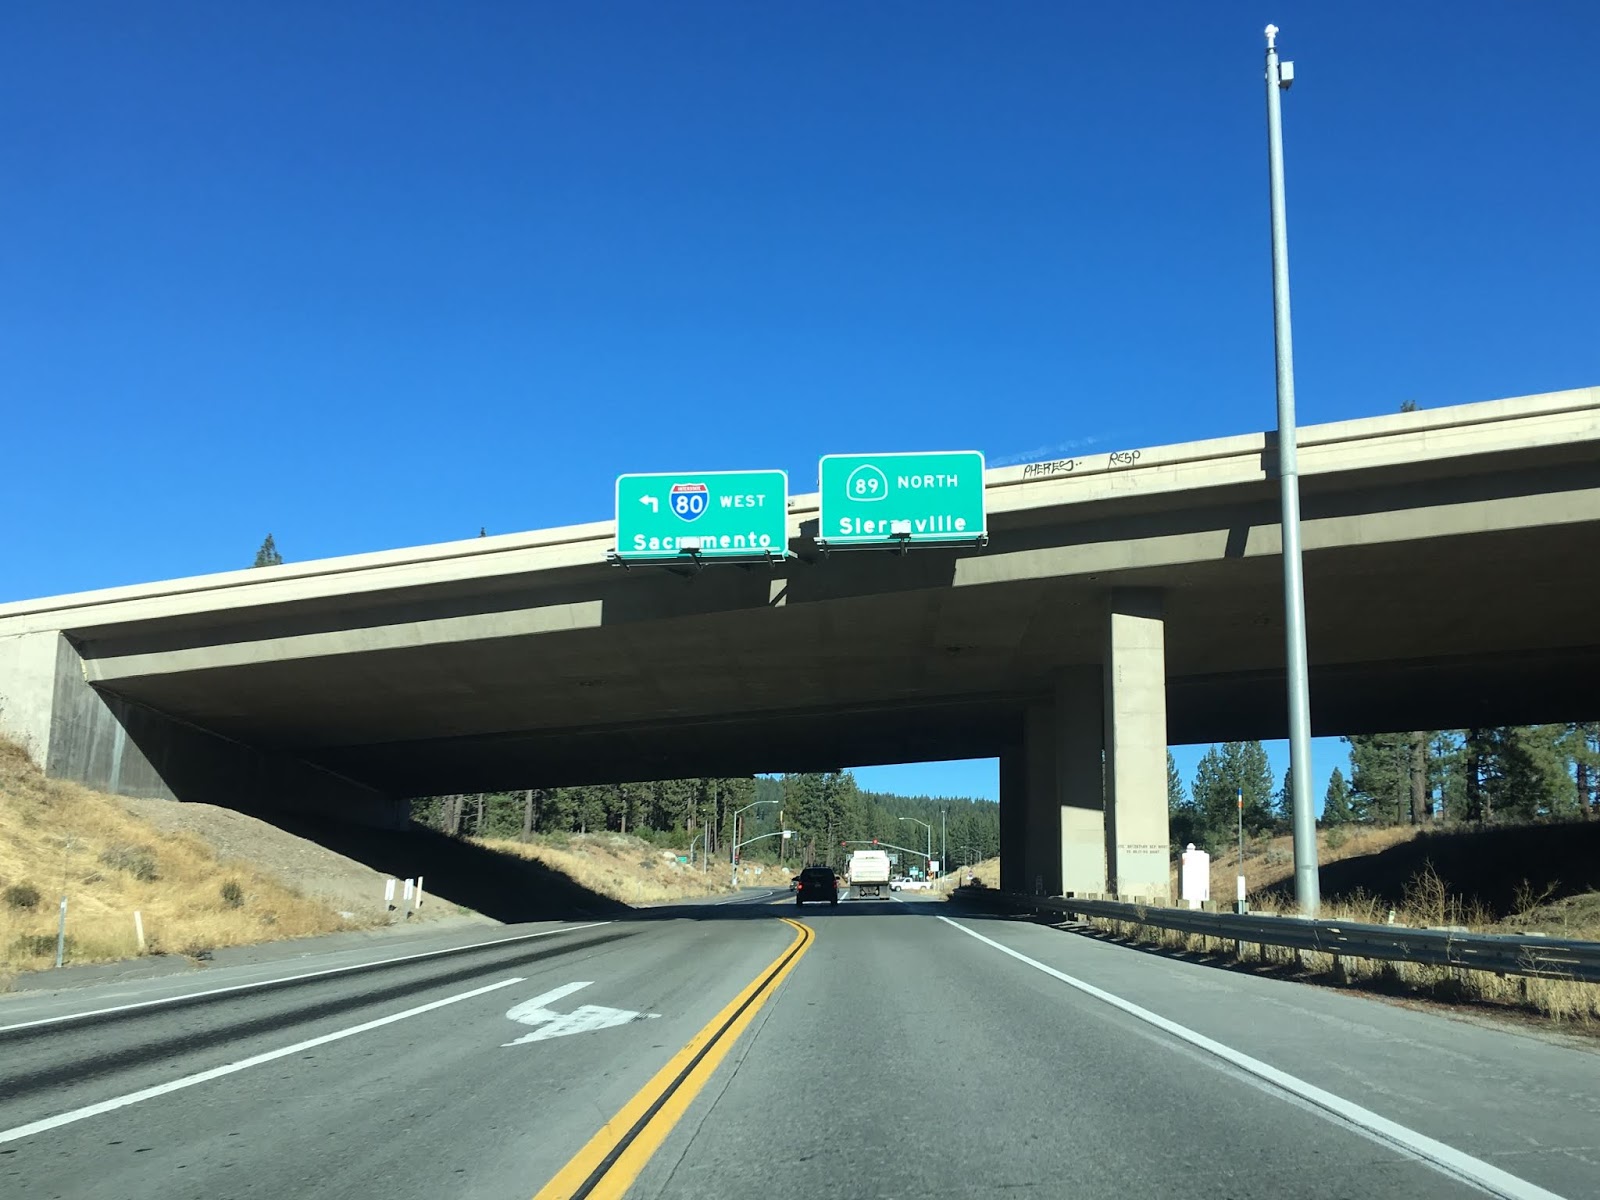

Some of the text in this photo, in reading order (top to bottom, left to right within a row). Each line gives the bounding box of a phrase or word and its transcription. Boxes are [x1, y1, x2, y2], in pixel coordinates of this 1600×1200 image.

[1107, 450, 1141, 470] RESP
[855, 474, 959, 495] 89 NORTH
[675, 494, 766, 514] 80 WEST
[839, 515, 966, 535] Sierville
[633, 531, 771, 551] Sacrmento
